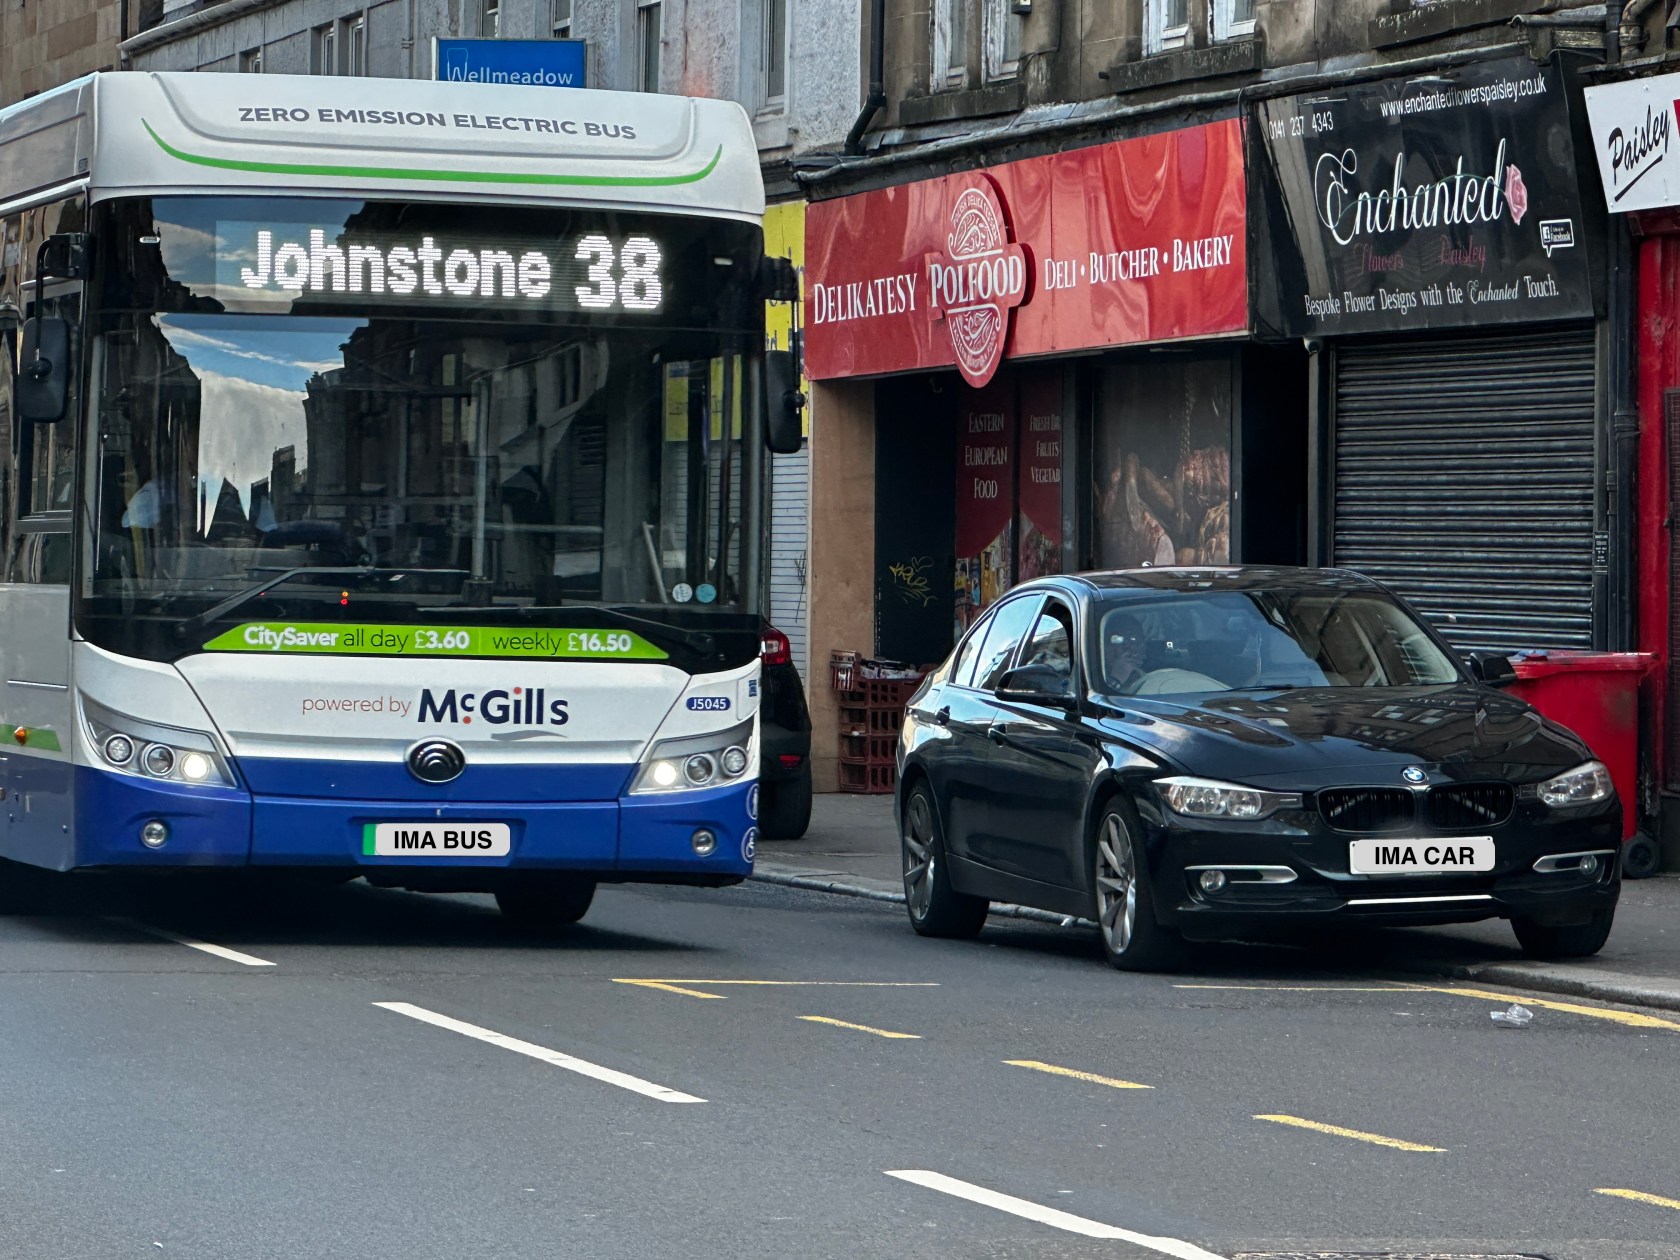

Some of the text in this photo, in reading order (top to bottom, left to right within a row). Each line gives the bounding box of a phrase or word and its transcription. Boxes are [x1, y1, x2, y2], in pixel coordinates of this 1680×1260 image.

[446, 61, 574, 85] Wellmeadow
[1380, 72, 1547, 117] www.enchantedflowerspaisley.co.uk
[238, 107, 636, 139] ZERO EMISSION ELECTRIC BUS
[1269, 111, 1334, 140] 0141 237 4343
[1608, 104, 1670, 186] Paisley
[1314, 138, 1506, 245] Enchanted
[240, 229, 662, 310] Johnstone 38
[1044, 235, 1234, 290] DELI BUTCHER BAKERY
[930, 255, 1023, 307] POLFOOD
[1304, 273, 1559, 321] Bespoke Flower Designs with the Enchanted Touch.
[813, 273, 917, 325] DELIKATESY
[969, 413, 1004, 433] EASTERN
[965, 445, 1008, 466] EUROPEAN
[974, 478, 998, 499] FOOD
[244, 627, 632, 656] CitySaver all day £3.60 weekly £16.50
[302, 686, 569, 726] powered by McGills
[691, 698, 727, 710] J5045
[393, 831, 493, 851] IMA BUS
[1375, 846, 1475, 865] IMA CAR
